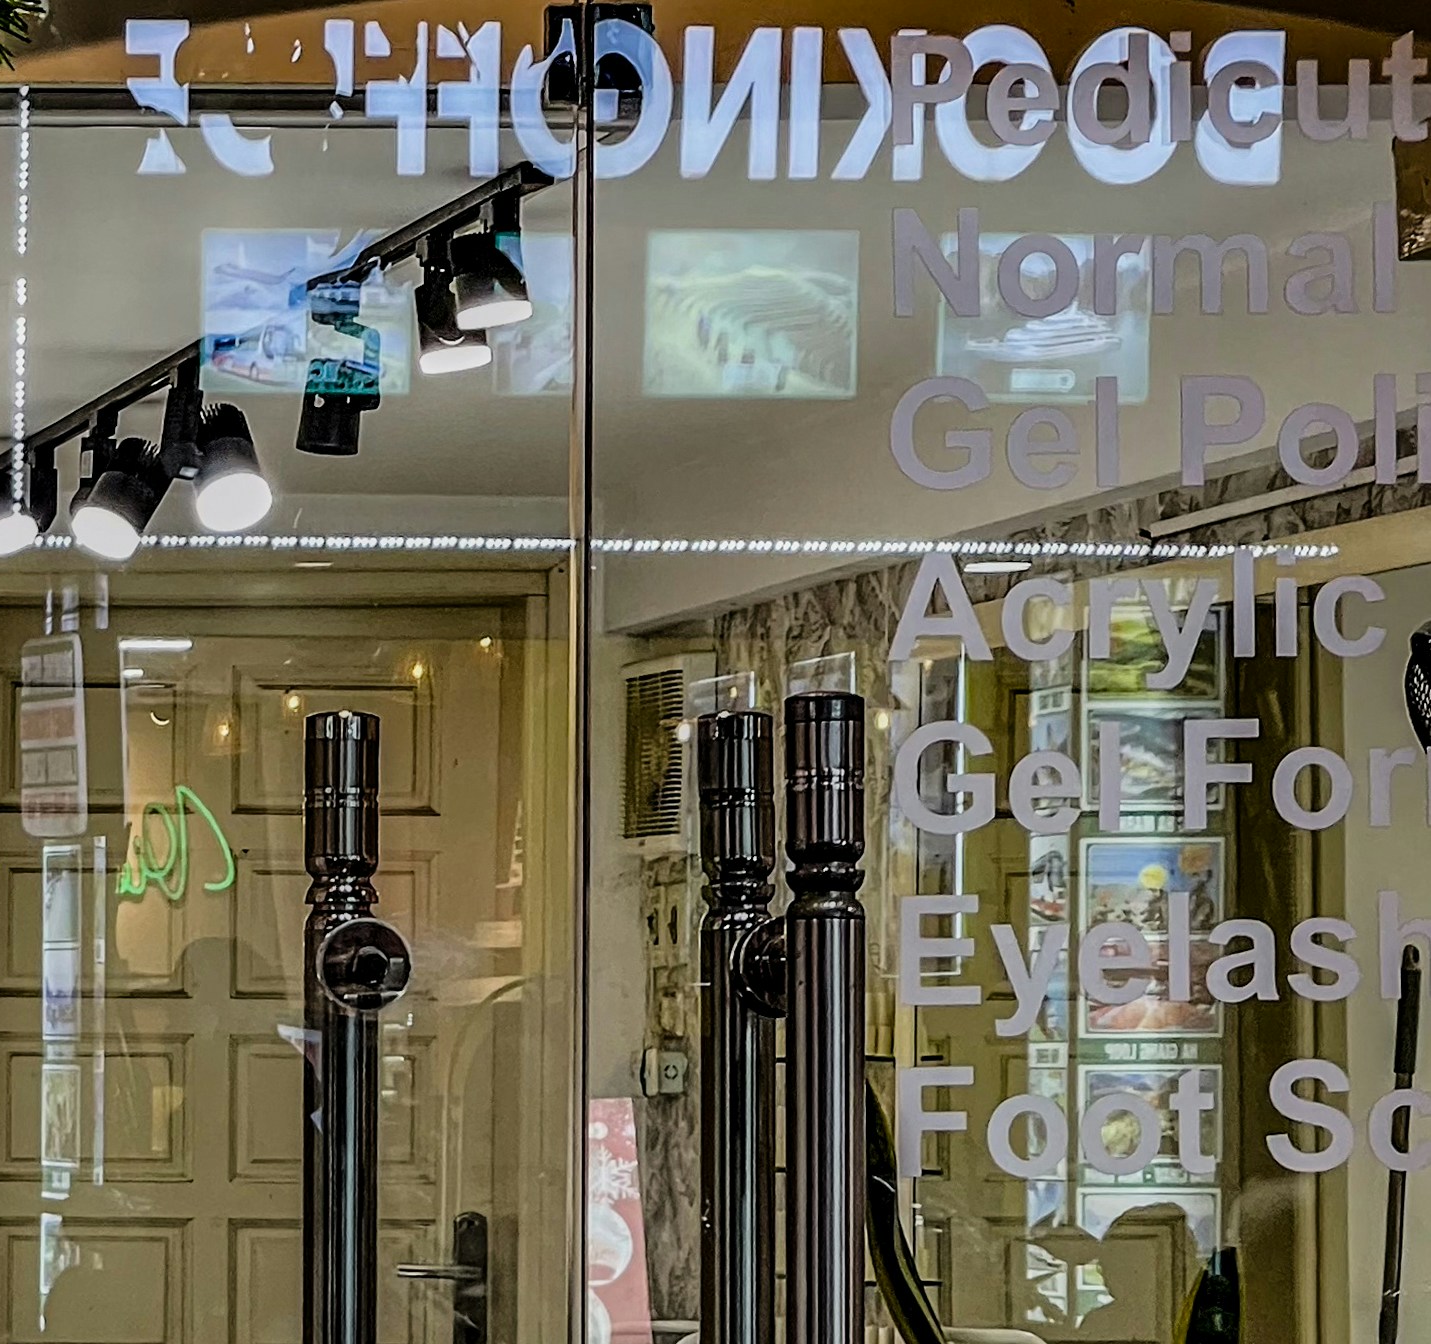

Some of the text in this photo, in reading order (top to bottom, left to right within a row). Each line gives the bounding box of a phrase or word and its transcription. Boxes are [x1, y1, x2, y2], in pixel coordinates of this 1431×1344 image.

[891, 200, 1398, 318] Normal
[888, 374, 1121, 491] Gel
[887, 546, 1388, 690] Acrylic
[894, 717, 1431, 836] Gel For
[897, 891, 1431, 1038] Eyelash
[896, 1058, 1431, 1179] Foot Sc
